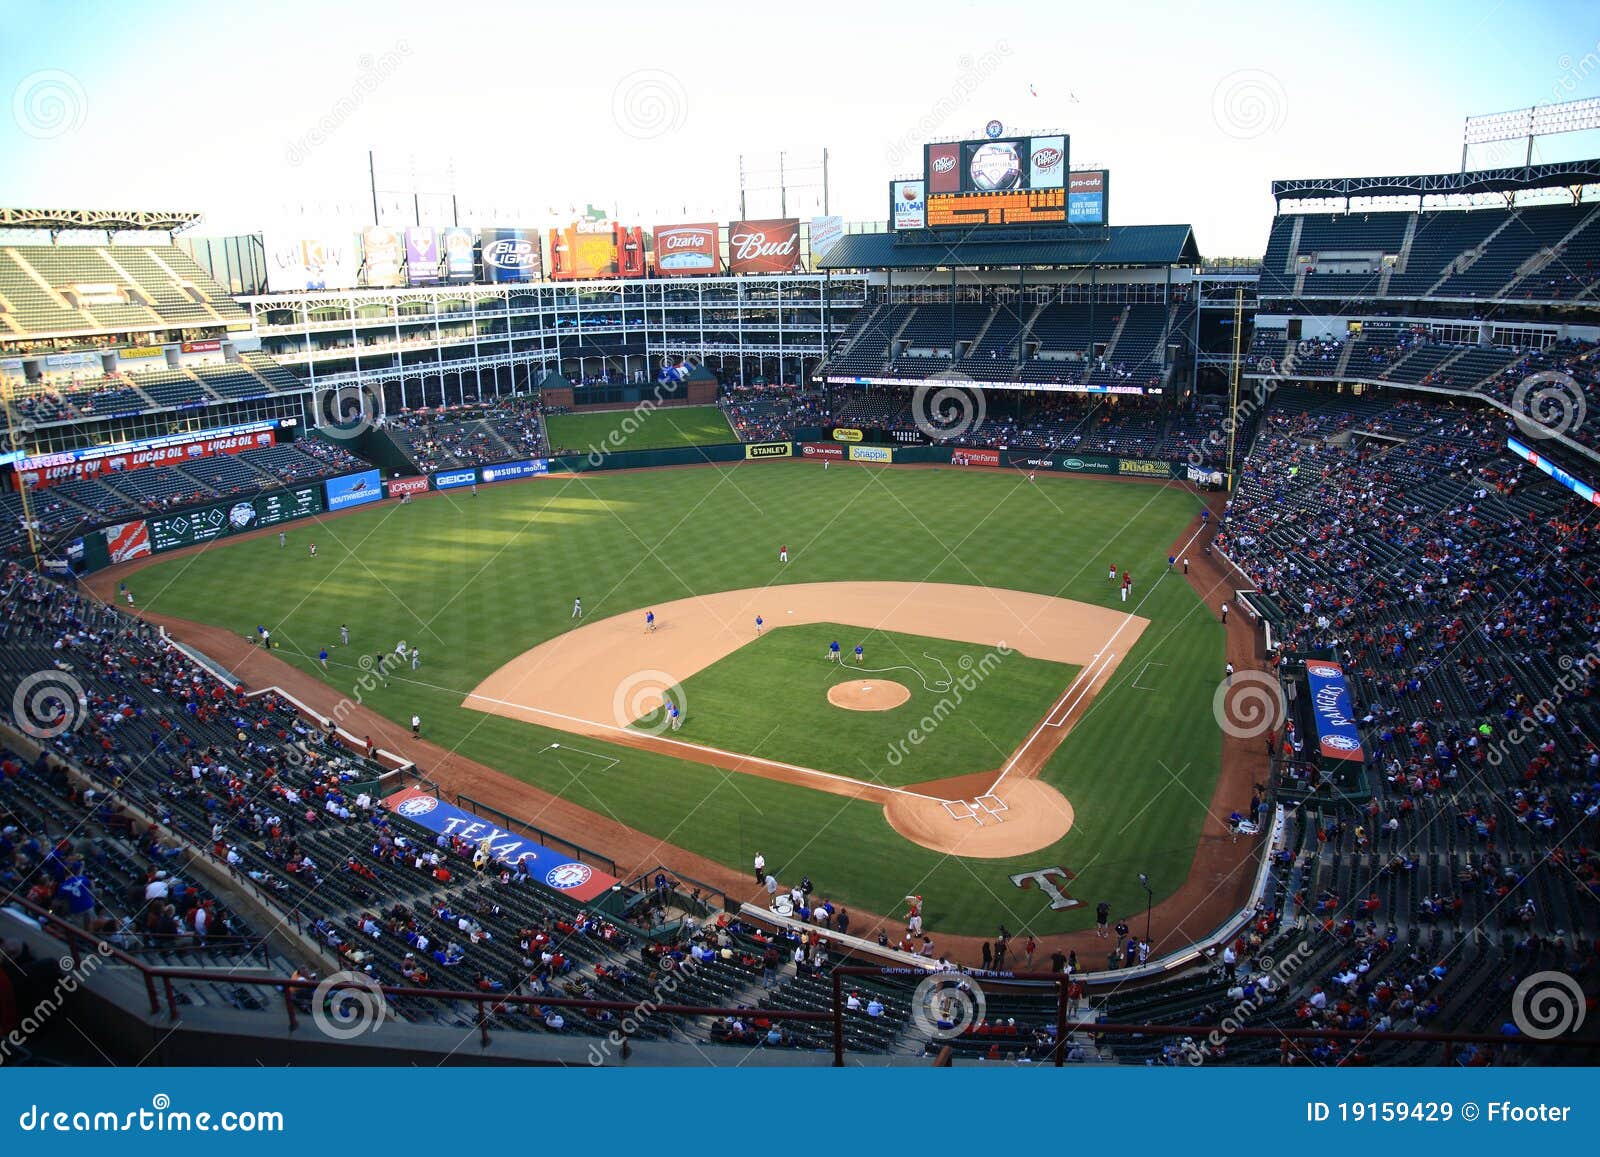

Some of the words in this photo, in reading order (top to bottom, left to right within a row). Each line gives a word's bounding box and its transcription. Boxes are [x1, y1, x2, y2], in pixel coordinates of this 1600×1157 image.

[496, 242, 531, 254] BUD
[667, 235, 705, 249] Ozarka
[732, 233, 798, 259] Bud
[490, 253, 538, 265] LIGHT
[208, 438, 238, 452] LUCAS
[238, 435, 253, 446] OIL
[752, 446, 786, 455] STANLEY
[133, 449, 166, 464] LUCAS
[167, 447, 183, 458] OIL
[854, 448, 888, 460] Snapple
[981, 454, 998, 462] Farm
[46, 463, 83, 480] LUCAS
[391, 479, 428, 493] JCPenney
[436, 473, 476, 486] GEICO
[1316, 684, 1352, 726] RANGERS
[443, 817, 537, 866] TEXAS
[1008, 865, 1084, 911] T
